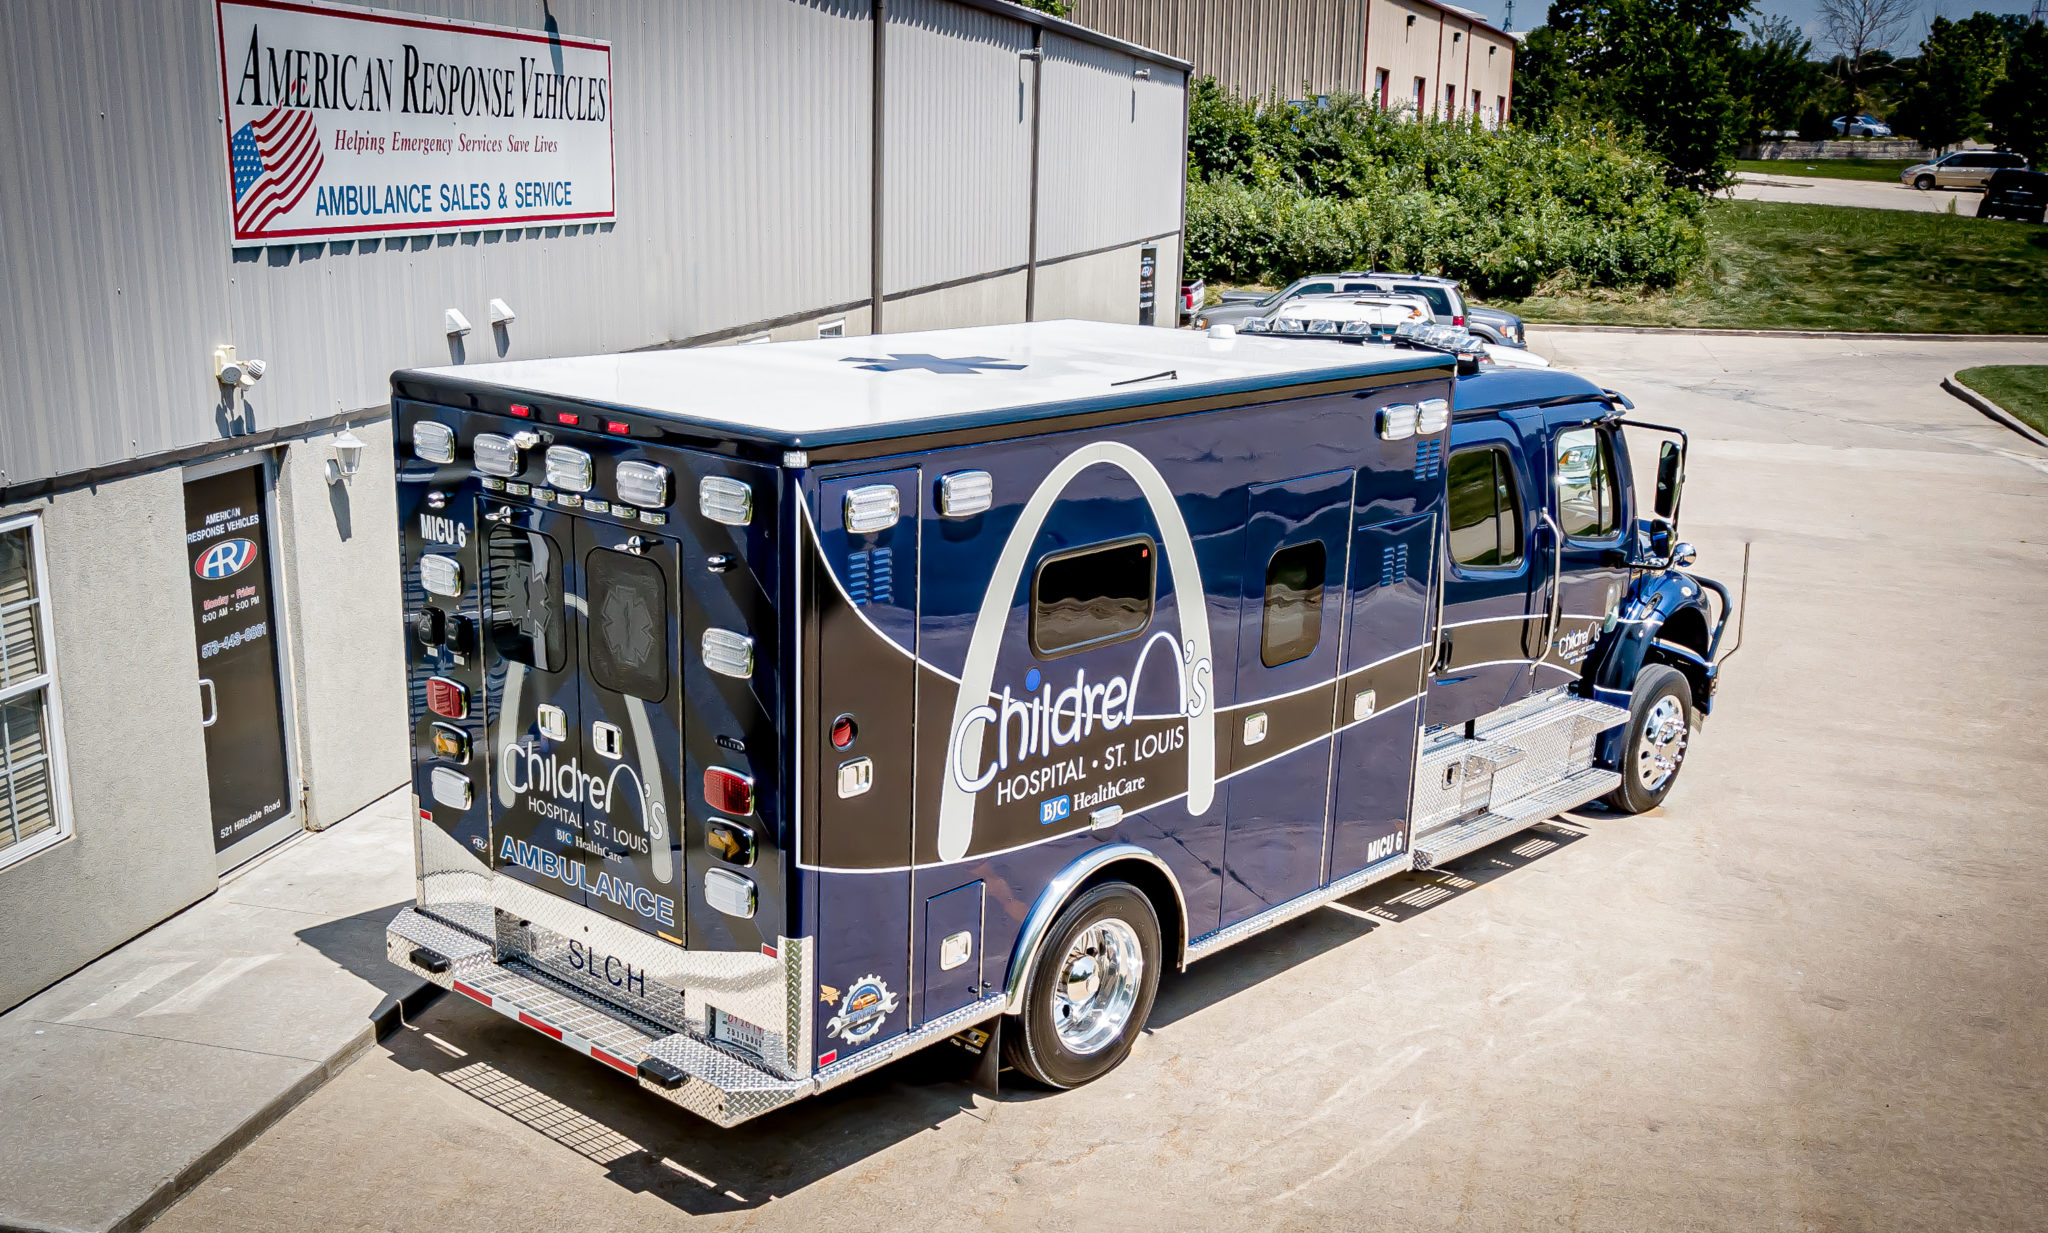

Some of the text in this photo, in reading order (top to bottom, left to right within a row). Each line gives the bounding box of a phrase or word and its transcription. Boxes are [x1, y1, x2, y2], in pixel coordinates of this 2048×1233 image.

[236, 24, 607, 122] AMERICAN RESPONSE VEHICLES
[335, 129, 558, 156] Helping Emergency Services Save Lives
[316, 181, 572, 216] AMBULANCE SALES & SERVICE
[187, 507, 259, 544] AMERICAN RESPONSE VEHICLES
[420, 513, 466, 548] MICU 6
[202, 611, 217, 624] 8:00
[218, 606, 228, 618] AM
[235, 600, 249, 612] 5:00
[250, 595, 260, 606] PM
[203, 595, 229, 611] Monday
[953, 631, 1211, 793] Children's
[997, 725, 1184, 806] HOSPITAL ST. LOUIS
[503, 741, 665, 840] Children's
[1043, 775, 1146, 822] BJC HealthCare
[220, 798, 281, 839] 521 Hillsdale Road
[528, 796, 649, 855] HOSPITAL ST. LOUIS
[556, 829, 623, 864] BJC HealthCare
[1367, 830, 1403, 863] MICU 6
[500, 835, 675, 928] AMBULANCE
[568, 938, 645, 998] SLCH
